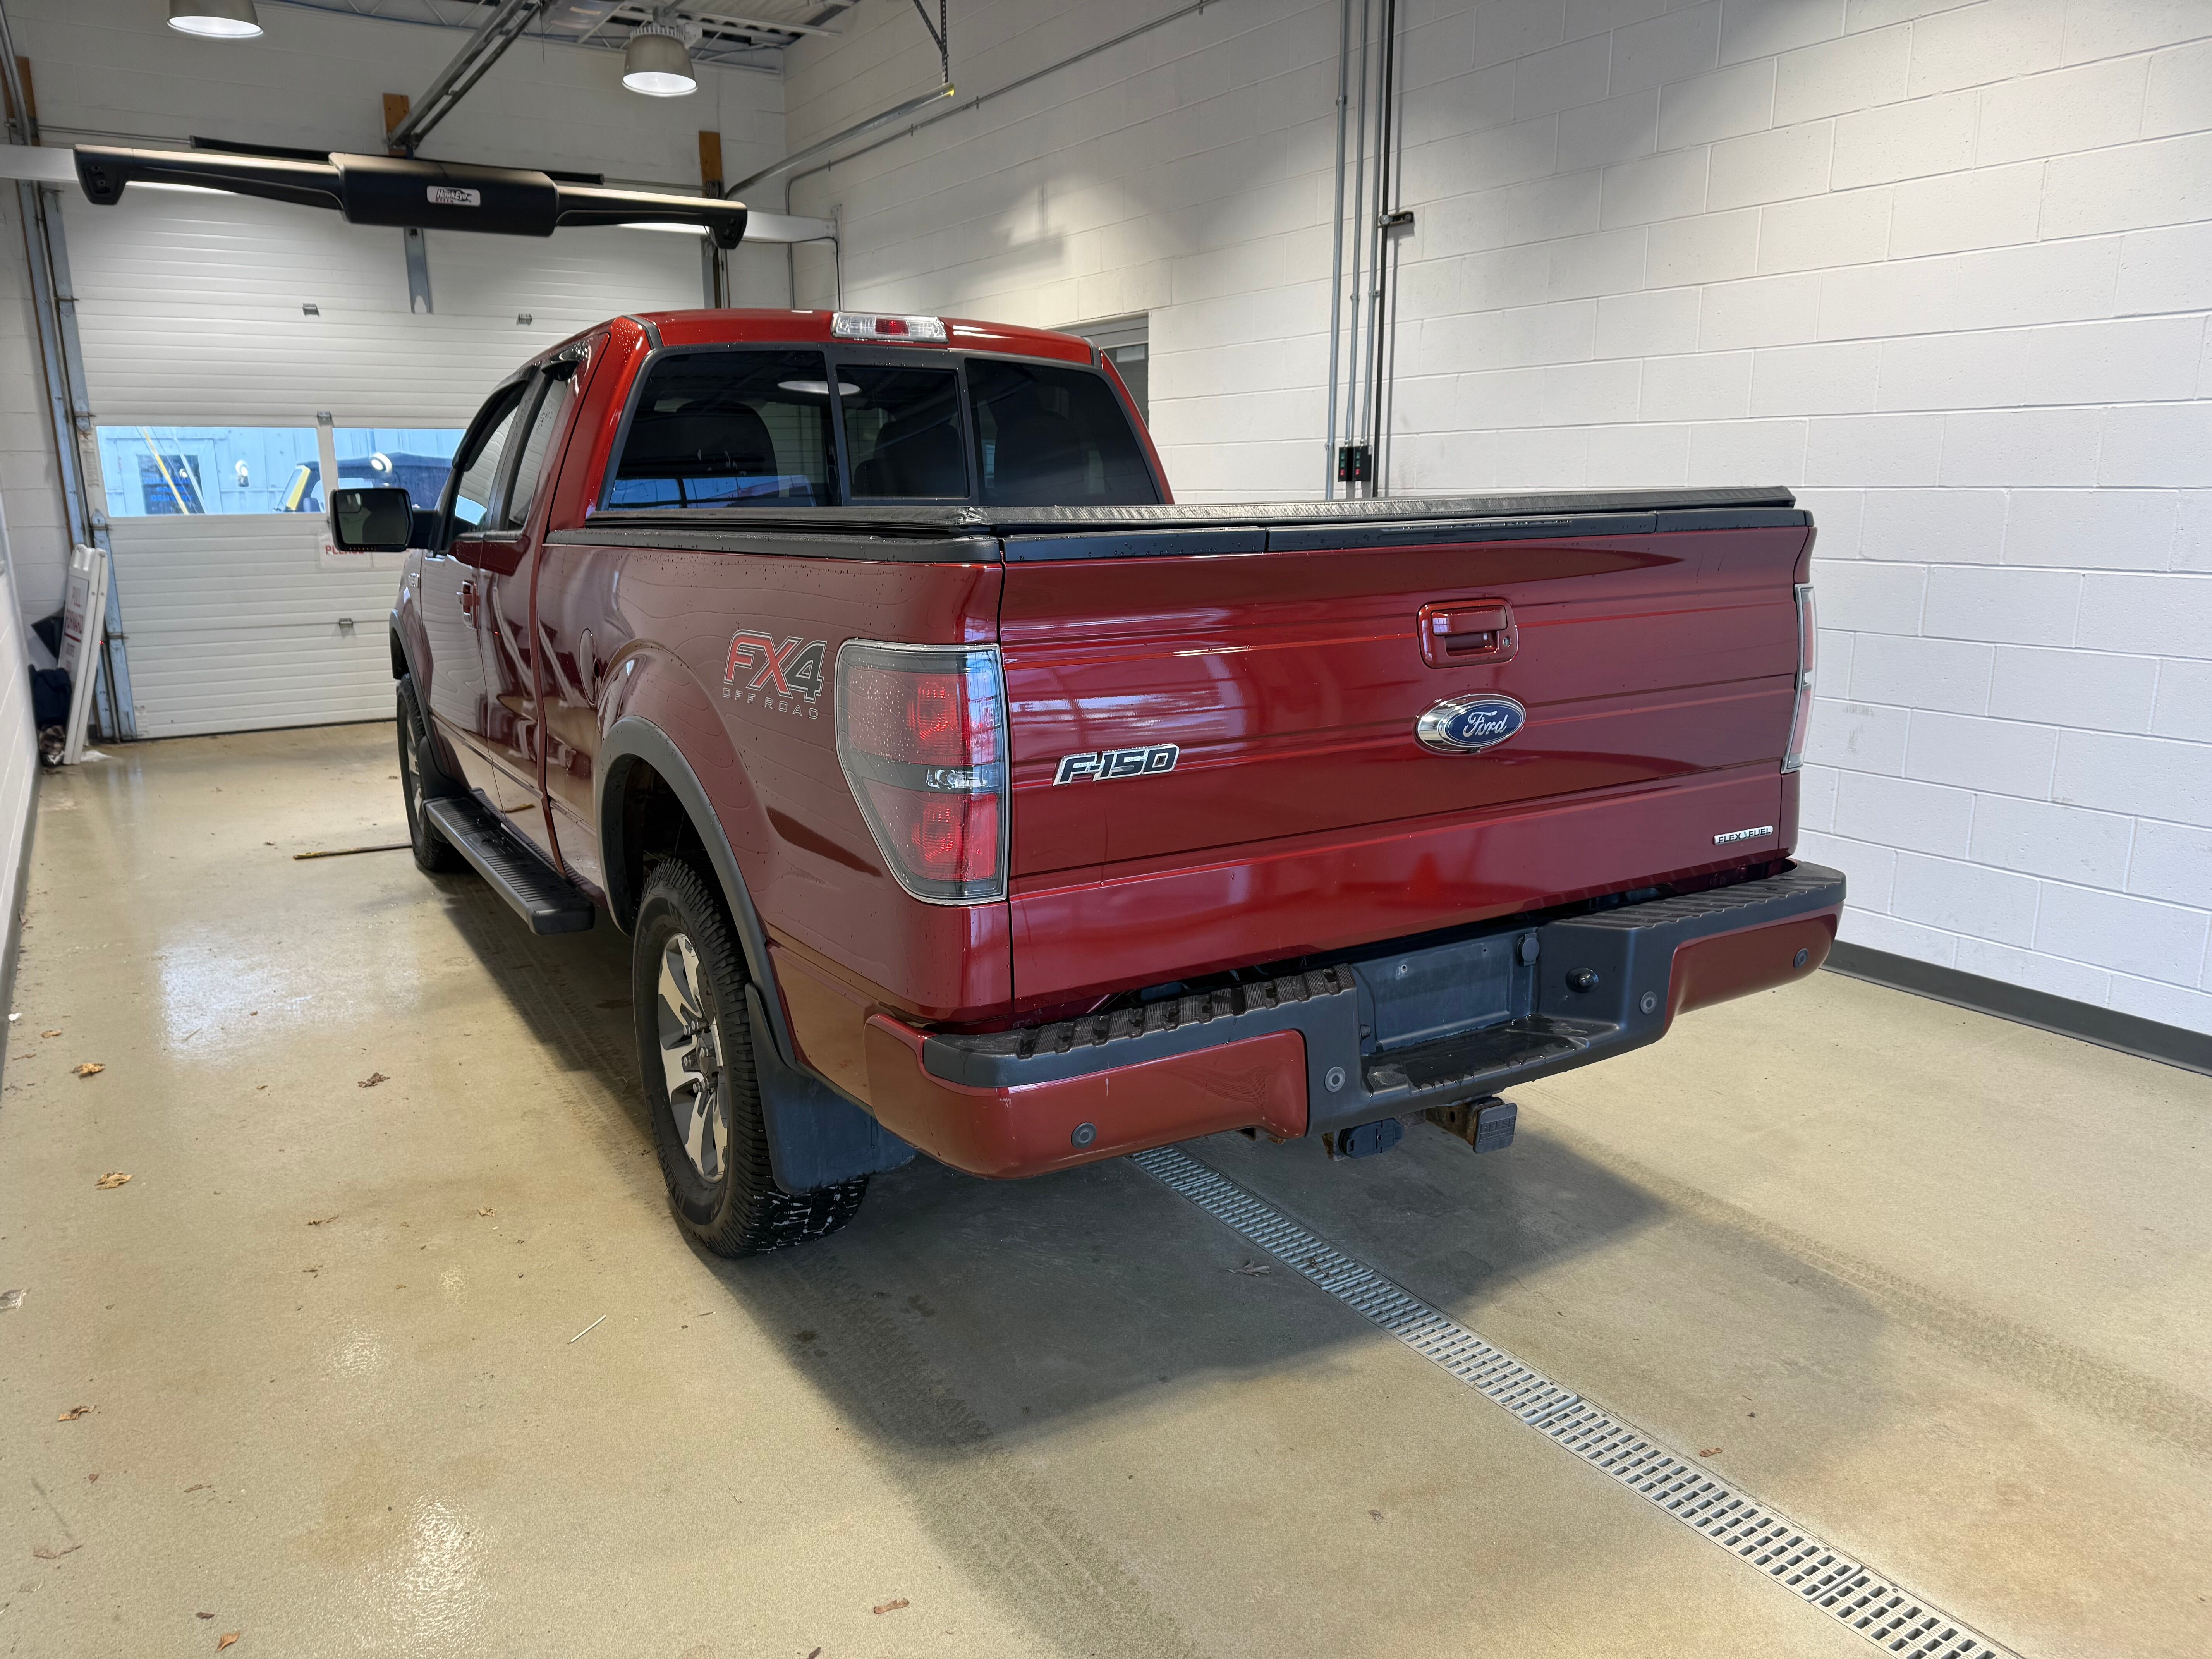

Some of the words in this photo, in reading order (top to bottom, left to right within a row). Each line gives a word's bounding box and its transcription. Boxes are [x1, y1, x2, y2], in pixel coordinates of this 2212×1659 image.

[723, 629, 828, 704] FX4
[722, 687, 756, 703] OFF
[764, 697, 819, 720] ROAD
[1463, 710, 1508, 738] Ford
[1052, 743, 1180, 787] F-150
[1718, 833, 1741, 844] FLEX
[1748, 828, 1771, 838] FUEL
